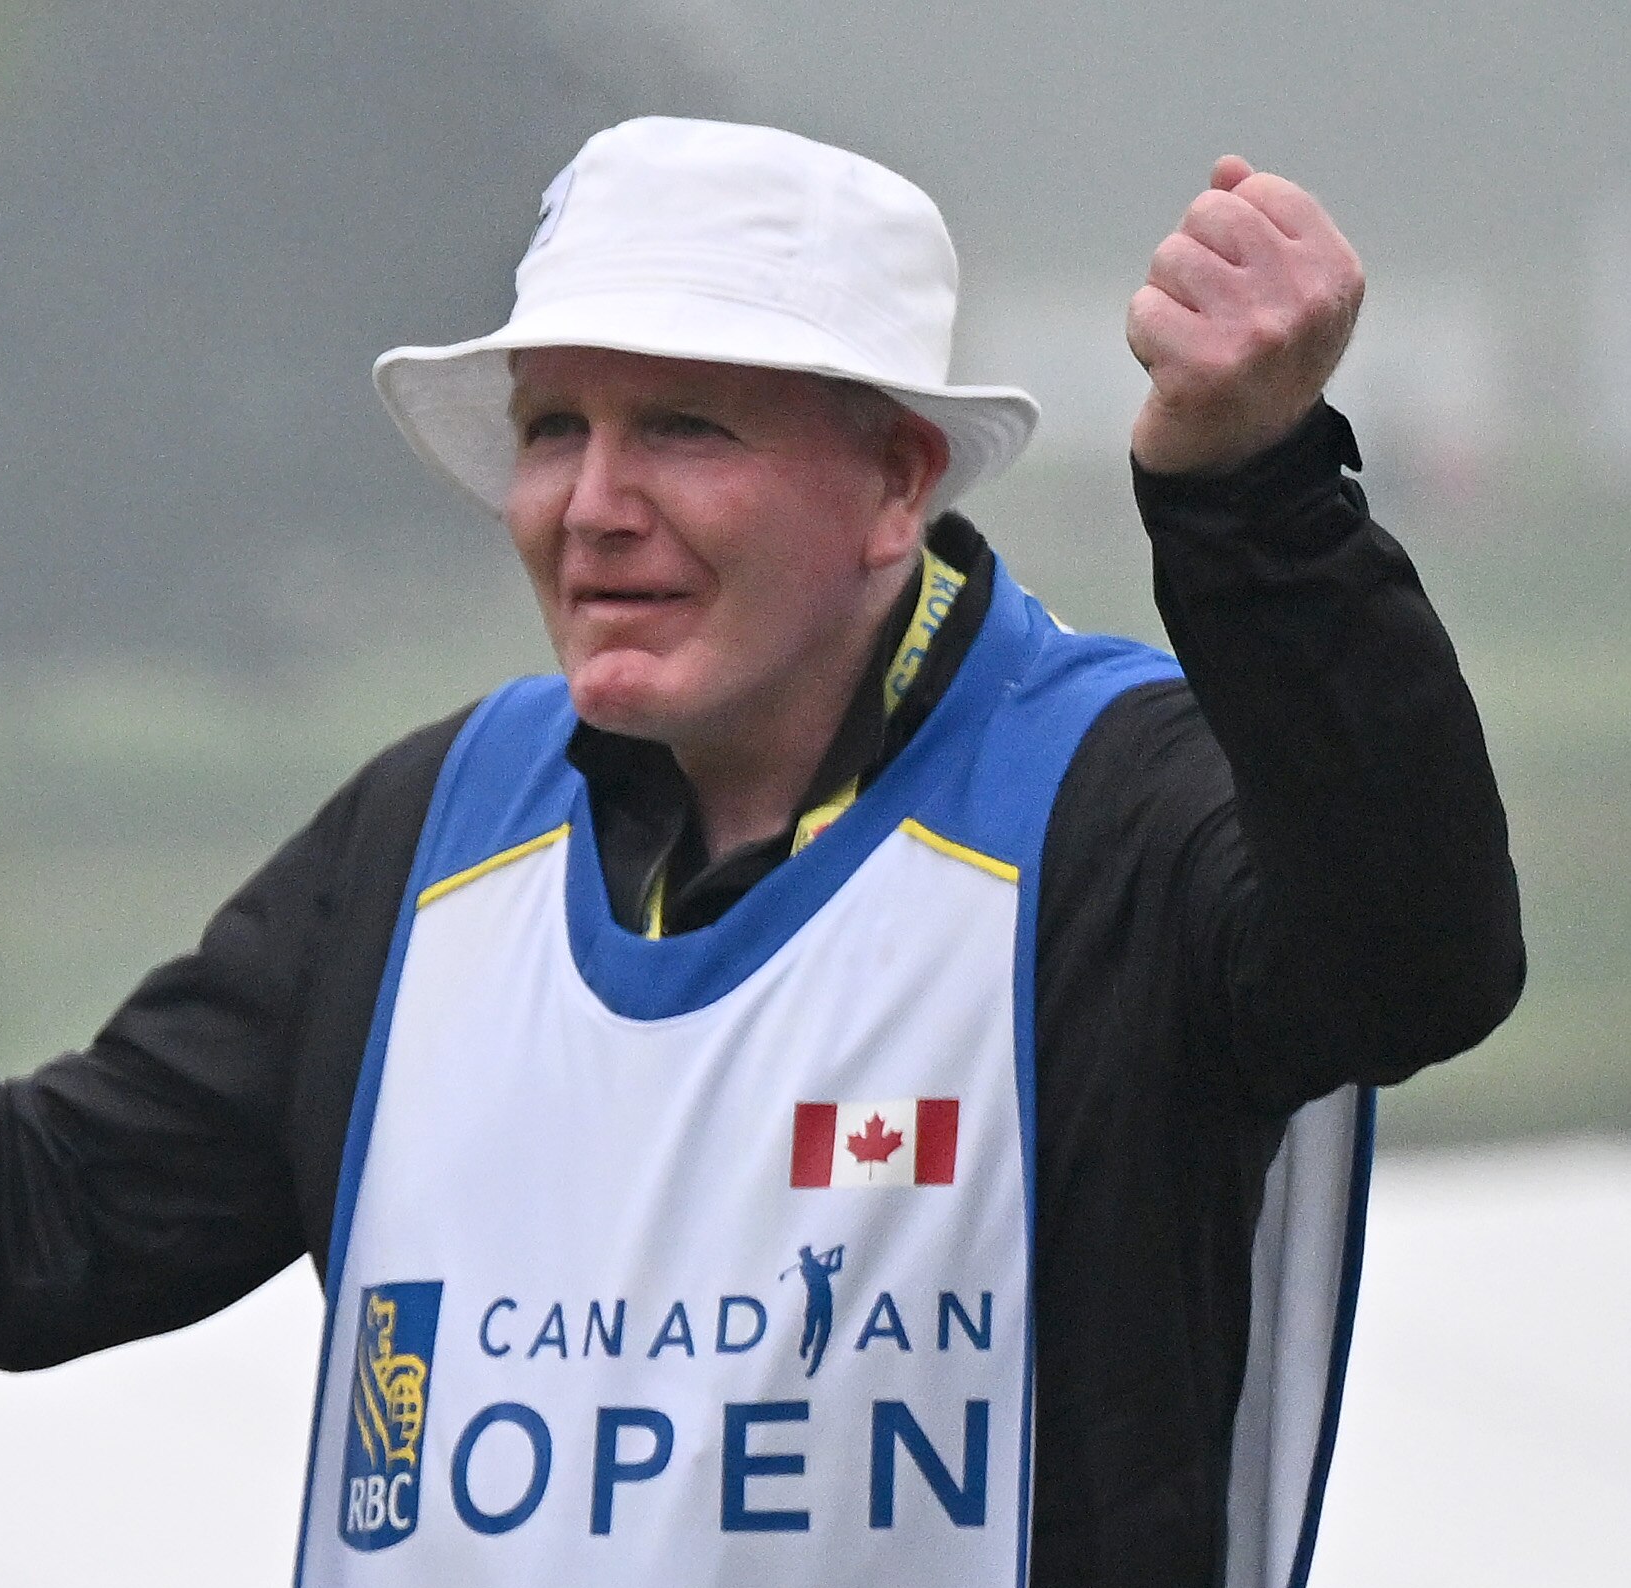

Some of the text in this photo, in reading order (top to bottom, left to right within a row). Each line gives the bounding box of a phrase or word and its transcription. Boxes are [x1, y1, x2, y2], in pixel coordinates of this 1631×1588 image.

[477, 1262, 994, 1376] CANADIAN
[346, 1472, 414, 1533] RBC
[449, 1400, 990, 1537] OPEN
